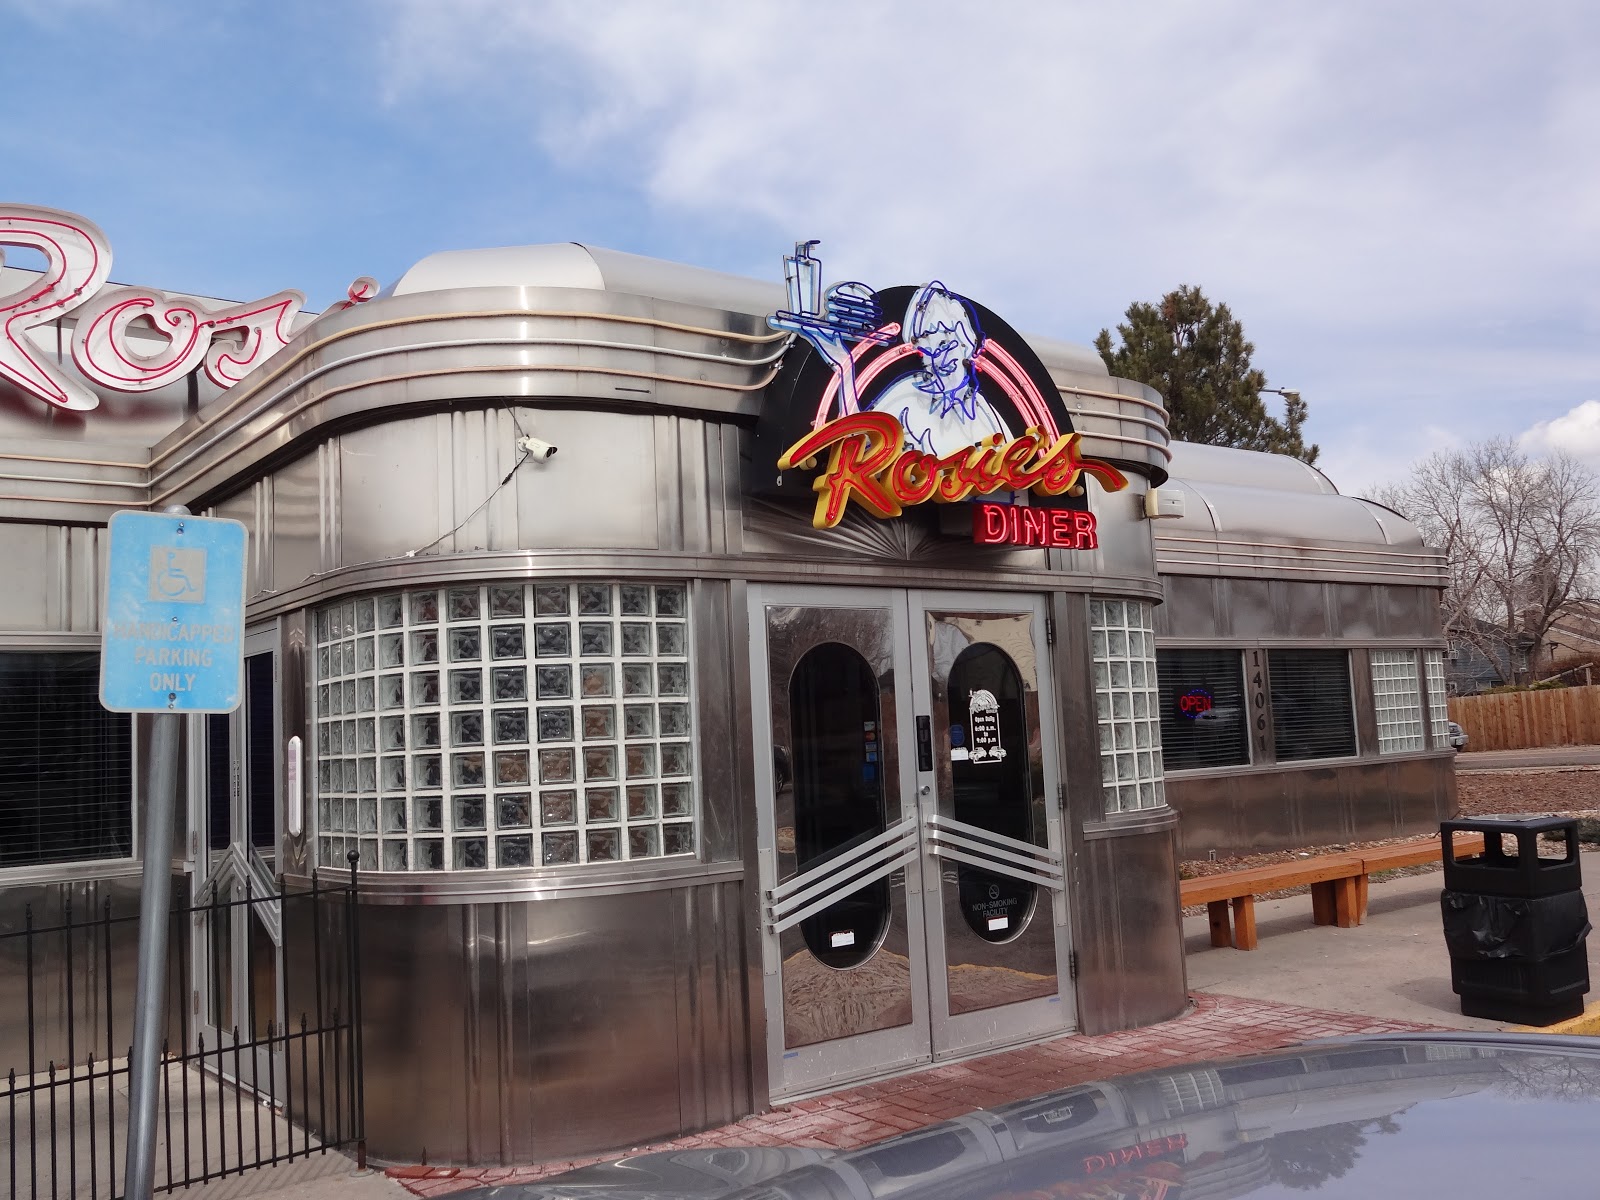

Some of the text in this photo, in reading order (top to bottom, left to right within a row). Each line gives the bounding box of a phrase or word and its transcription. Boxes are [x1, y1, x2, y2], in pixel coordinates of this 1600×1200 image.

[777, 411, 1129, 530] Rosie's
[974, 503, 1098, 549] DINER
[113, 620, 235, 643] HANDICAPPED
[134, 647, 213, 667] PARKING
[150, 672, 196, 692] ONLY
[1180, 695, 1211, 712] OPEN
[1253, 650, 1266, 752] 14061
[972, 898, 1018, 912] NON-SMOKING
[982, 907, 1008, 918] FACILITY
